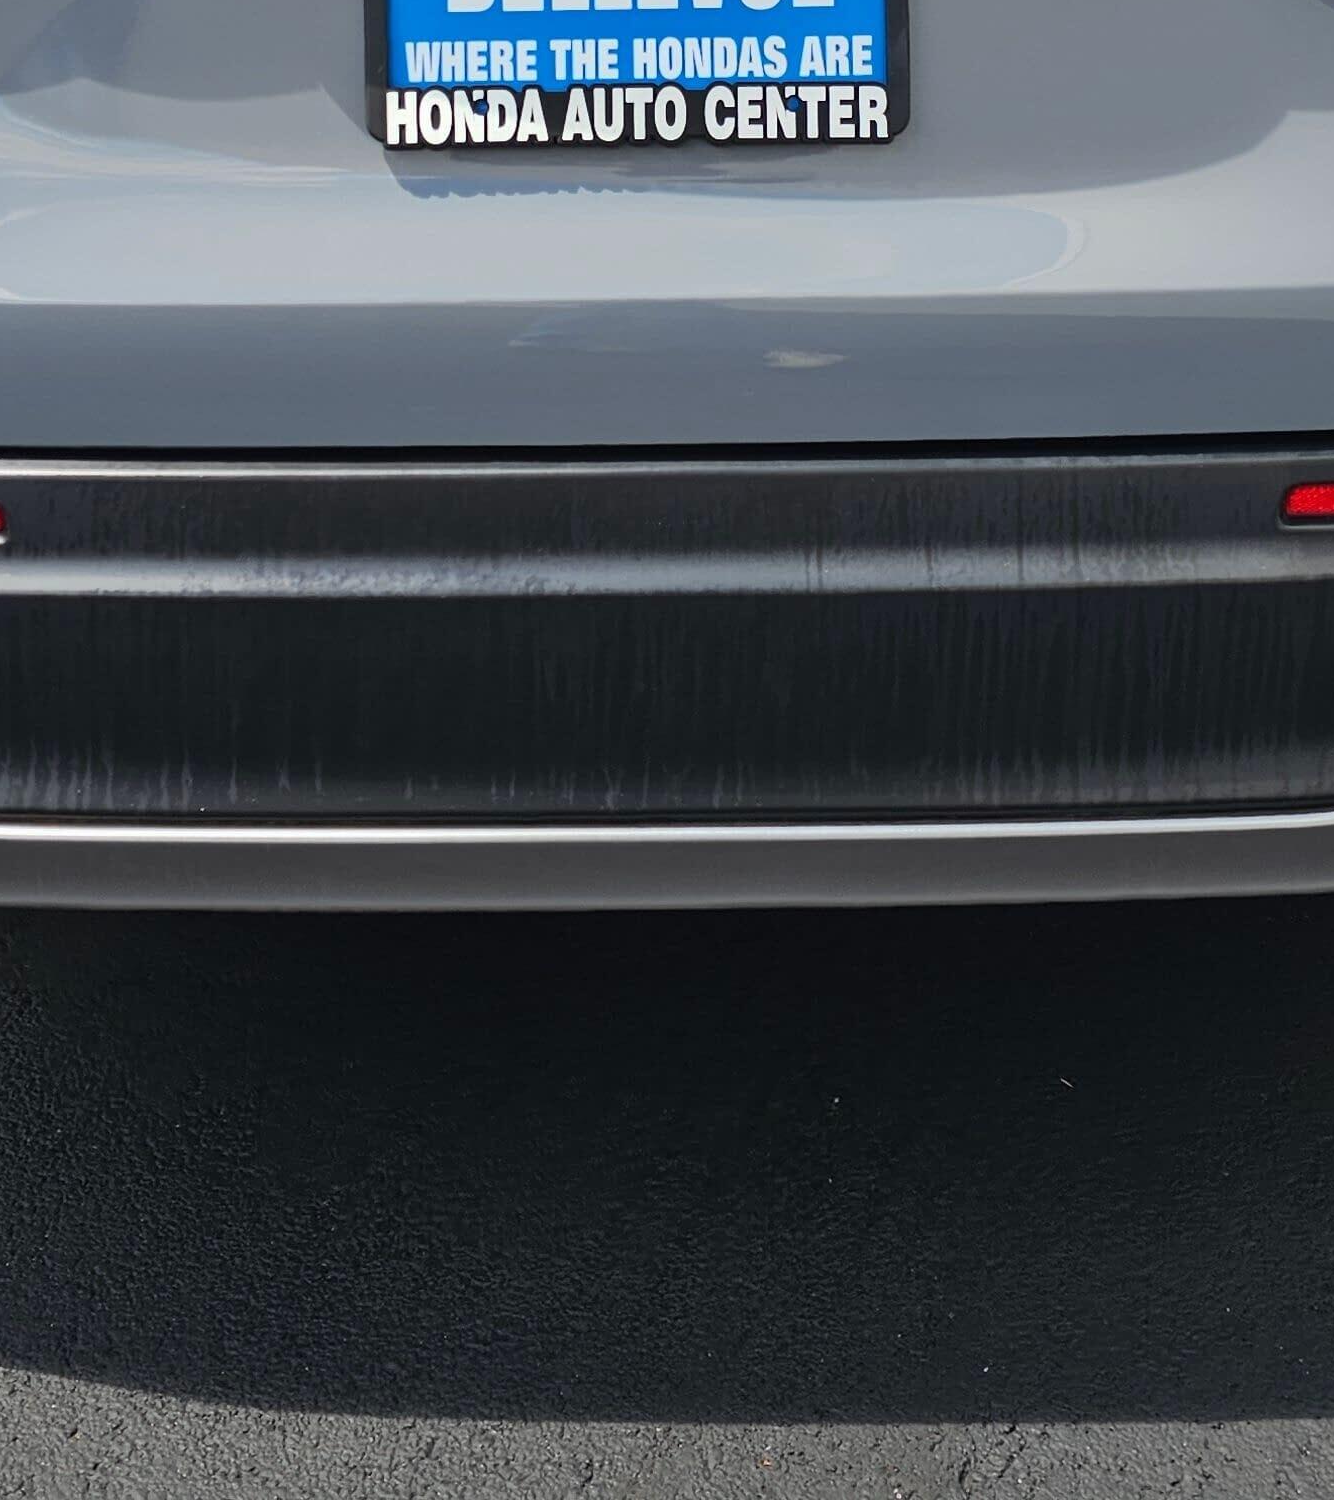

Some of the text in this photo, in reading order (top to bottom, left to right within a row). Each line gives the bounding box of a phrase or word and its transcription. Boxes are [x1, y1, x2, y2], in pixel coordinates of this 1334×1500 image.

[405, 34, 873, 83] WHERE THE HONDAS ARE
[385, 85, 889, 145] HONDA AUTO CENTER
